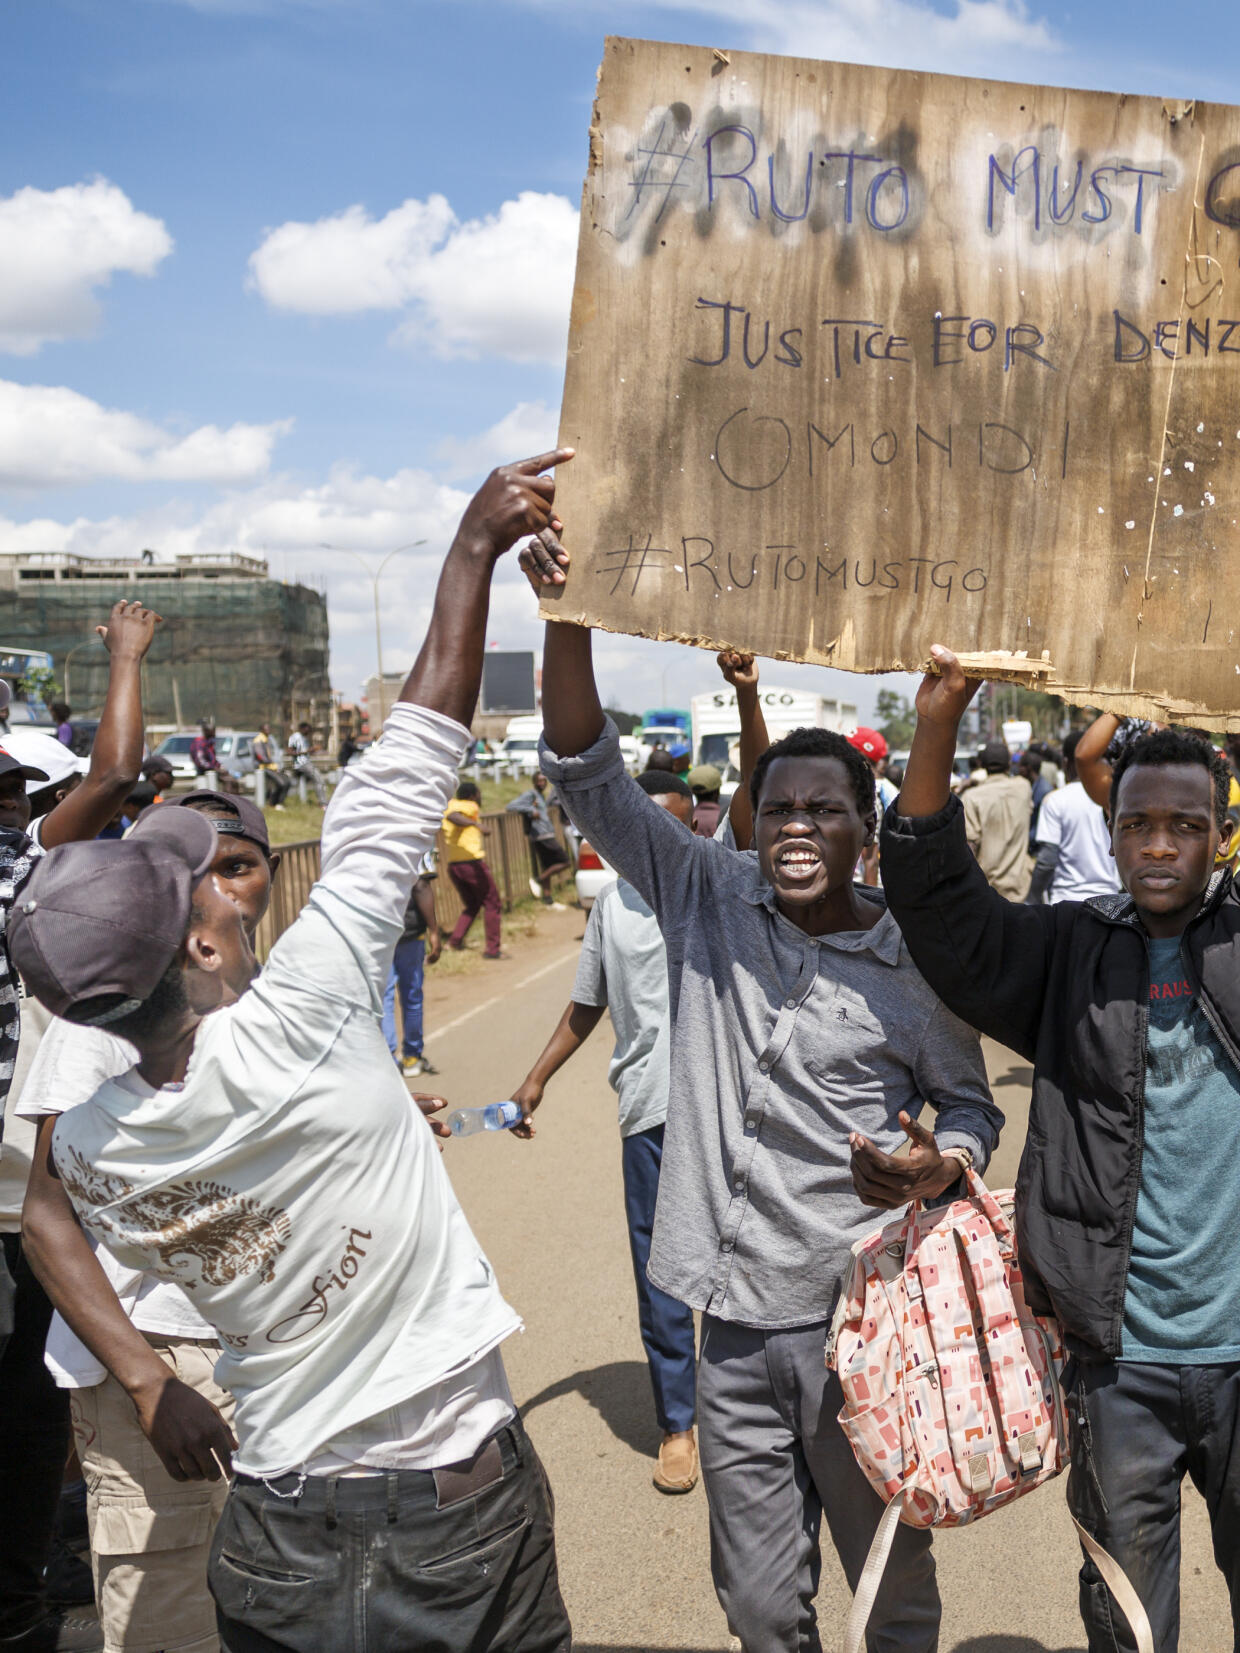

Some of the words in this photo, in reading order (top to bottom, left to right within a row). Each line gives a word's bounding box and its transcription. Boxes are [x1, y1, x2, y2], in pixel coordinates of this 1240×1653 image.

[625, 121, 909, 231] #RUTO
[987, 146, 1164, 234] MUST
[688, 297, 911, 378] JUSTICE
[715, 407, 1070, 491] OMONDI
[596, 533, 988, 602] #RUTOMUSTGO
